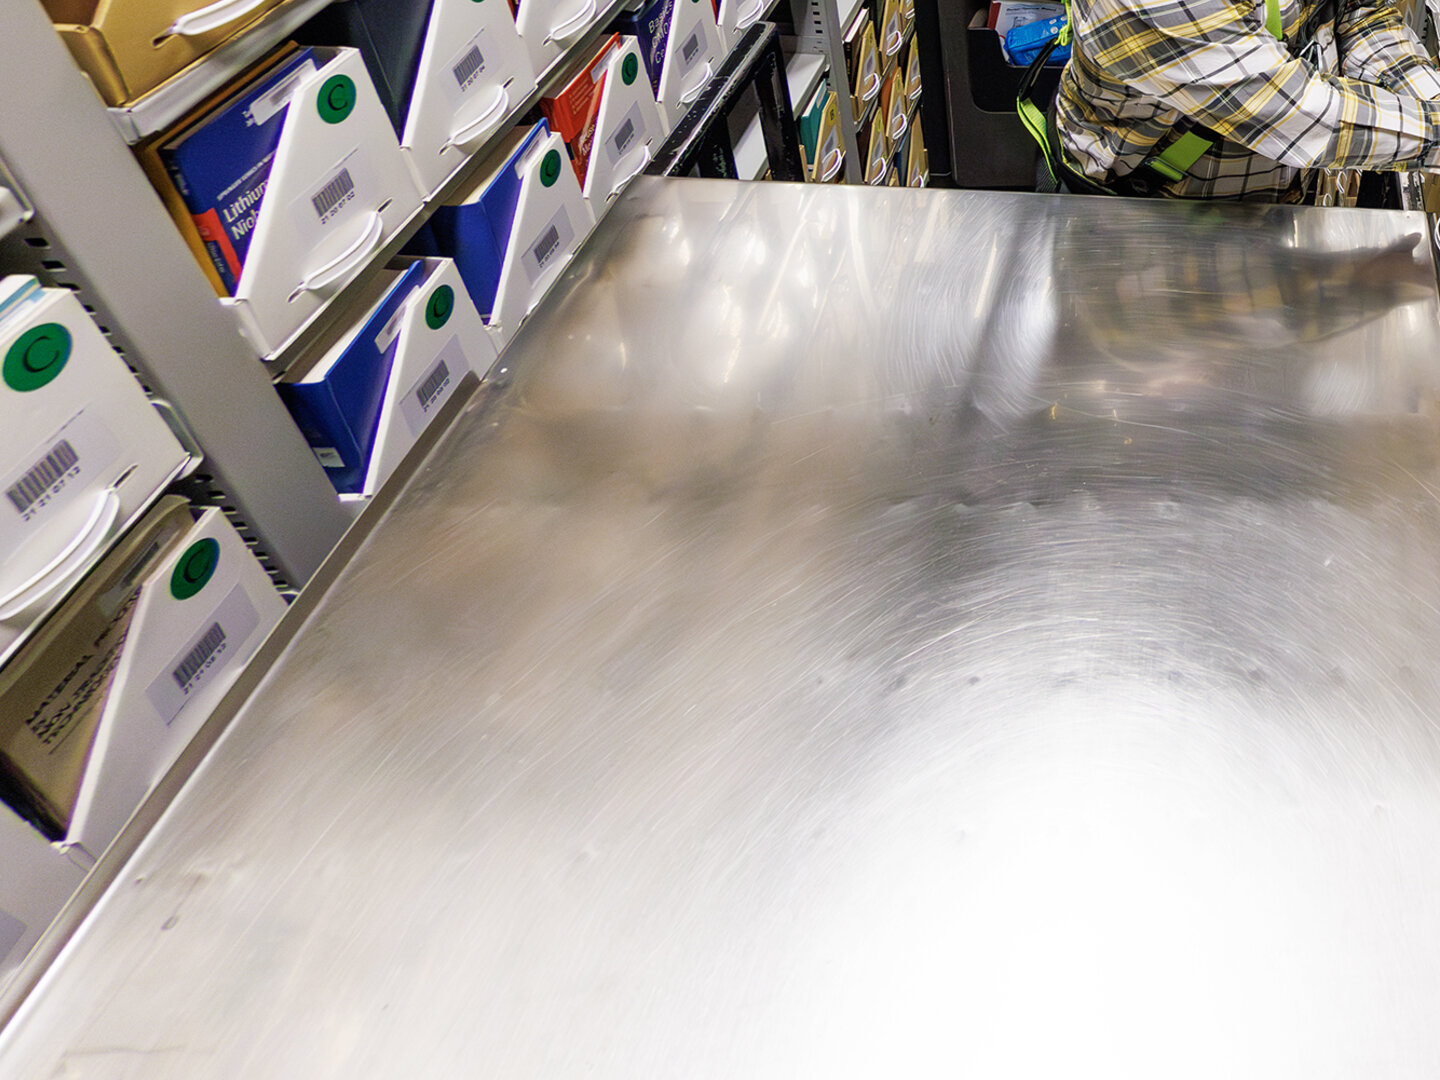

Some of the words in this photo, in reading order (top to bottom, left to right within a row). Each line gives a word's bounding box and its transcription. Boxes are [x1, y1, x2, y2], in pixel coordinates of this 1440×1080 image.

[328, 84, 347, 111] C
[319, 214, 329, 225] 21
[328, 206, 338, 216] 20
[336, 198, 346, 208] 07
[345, 190, 355, 200] 02
[432, 298, 449, 320] C
[23, 336, 59, 373] C
[21, 507, 35, 522] 21
[37, 494, 50, 508] 21
[51, 478, 66, 494] 07
[66, 465, 81, 480] 12
[186, 551, 209, 583] C
[182, 682, 193, 695] 21
[193, 668, 205, 681] 21
